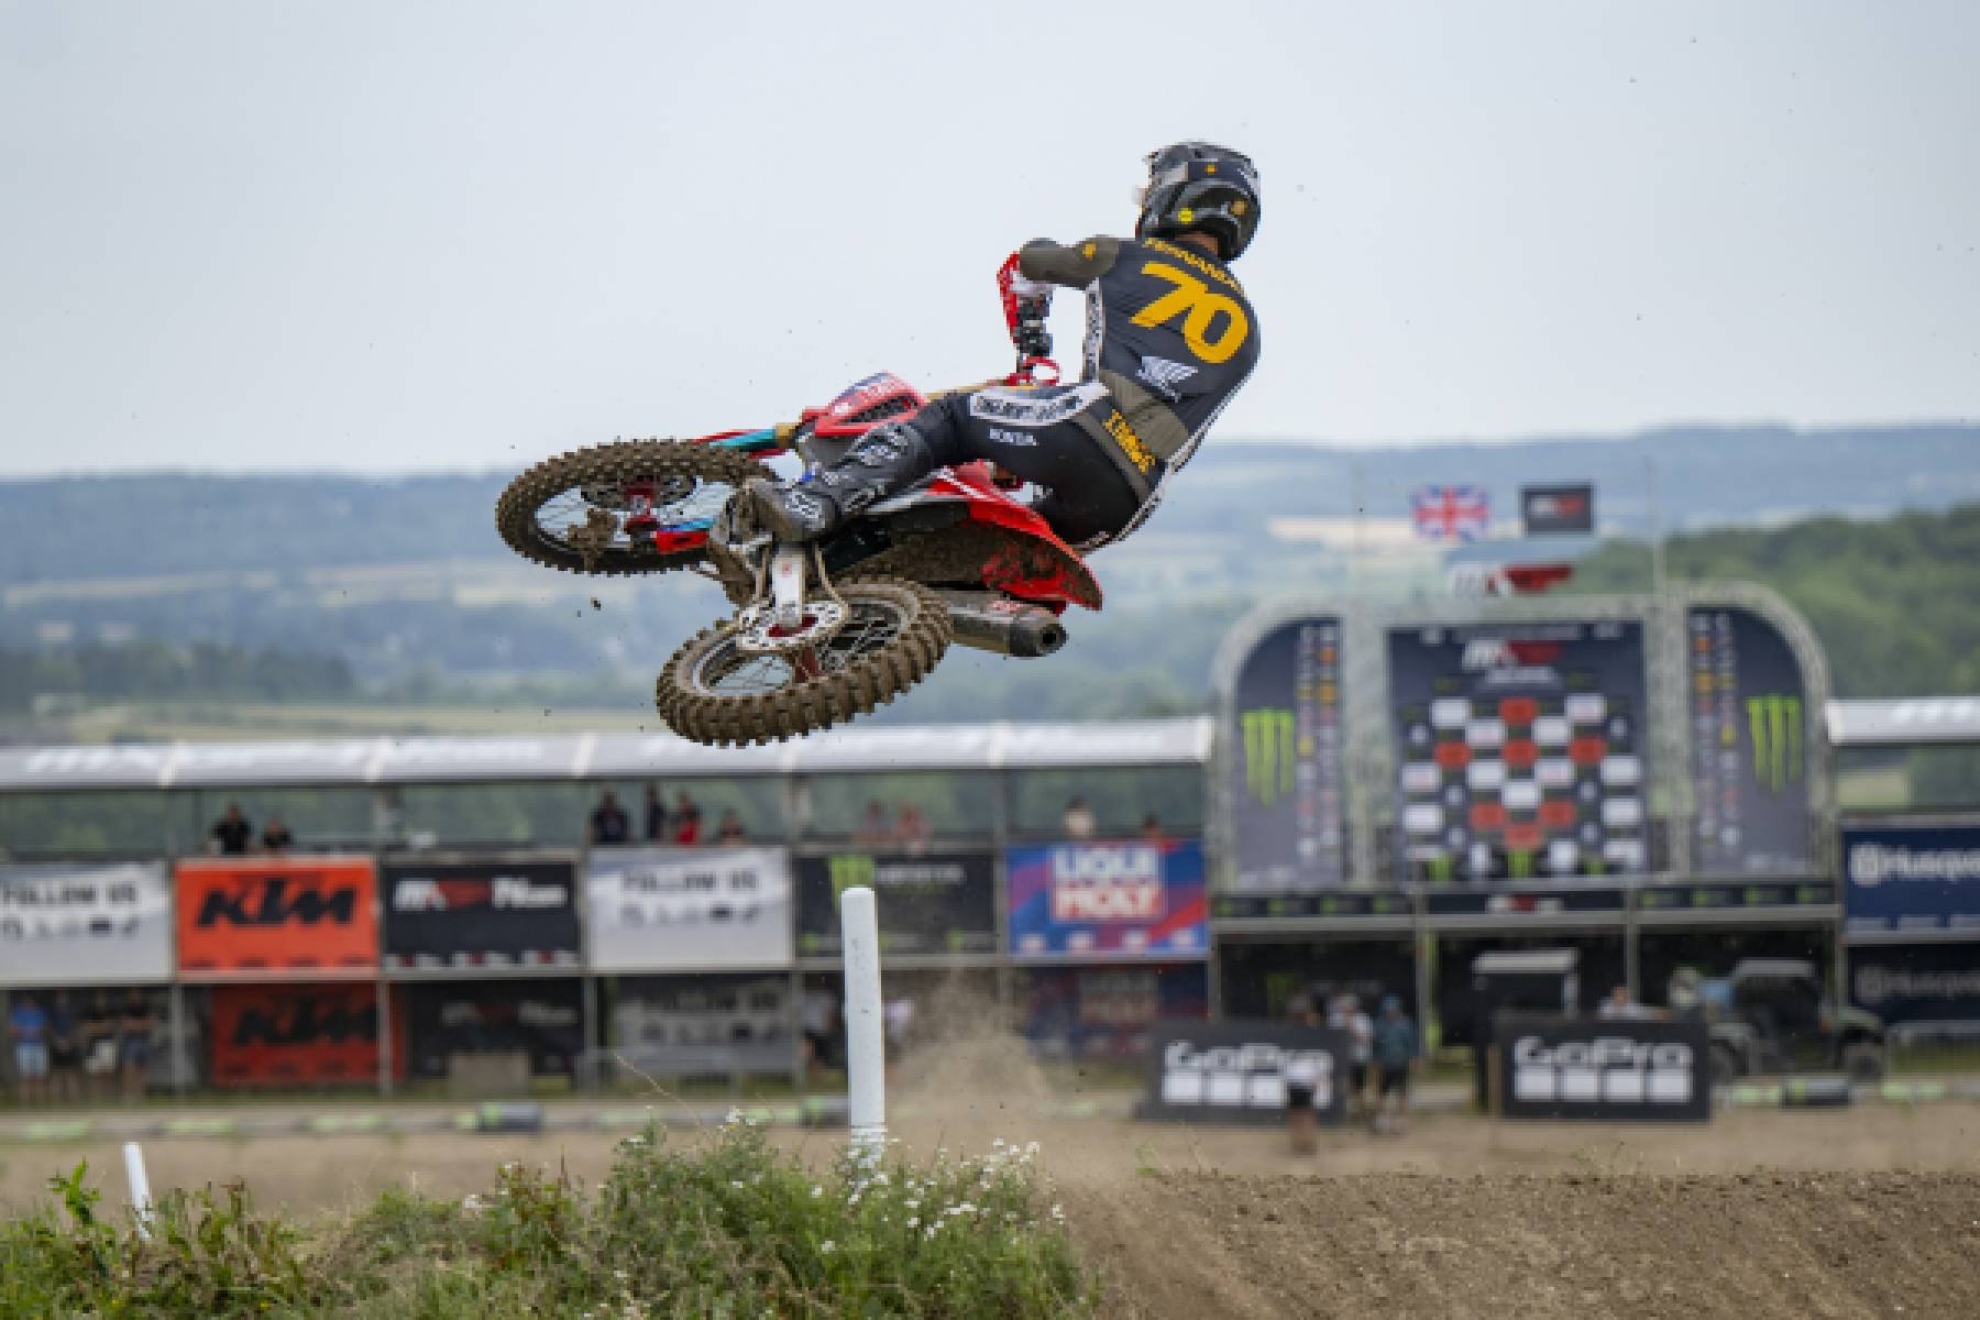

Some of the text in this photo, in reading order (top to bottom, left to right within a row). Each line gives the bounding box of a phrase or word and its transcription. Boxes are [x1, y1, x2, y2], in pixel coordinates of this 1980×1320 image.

[1130, 262, 1249, 364] 70
[198, 876, 356, 926] KTM
[1514, 1036, 1693, 1070] GoPro
